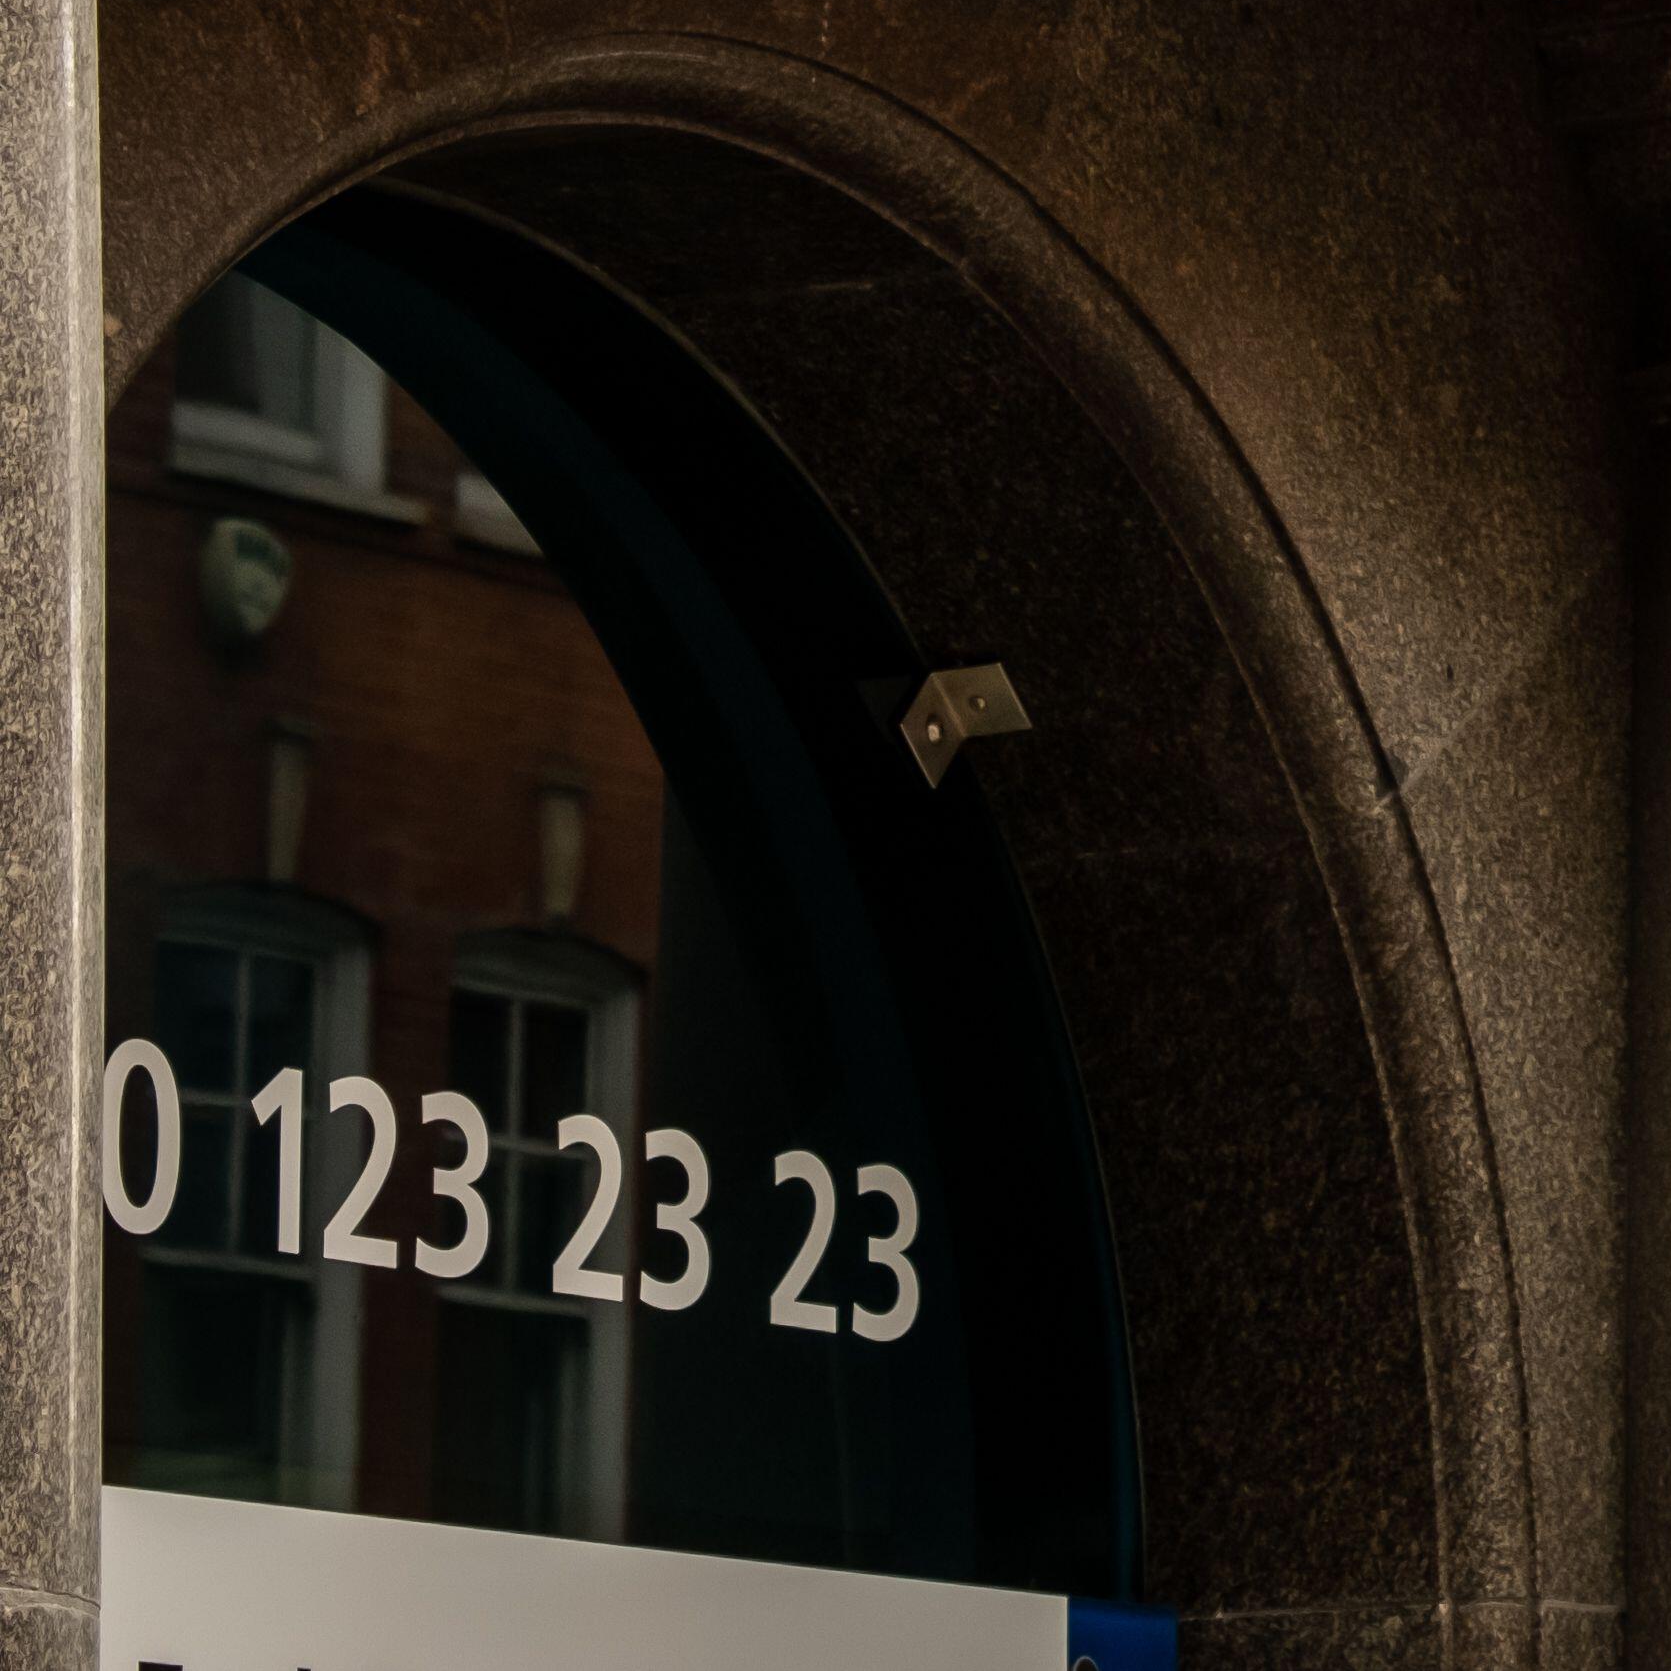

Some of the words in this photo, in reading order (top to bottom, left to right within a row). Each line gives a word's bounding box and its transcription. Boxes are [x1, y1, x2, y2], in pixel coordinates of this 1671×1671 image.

[251, 1067, 489, 1277] 123
[553, 1115, 710, 1310] 23
[770, 1151, 920, 1341] 23
